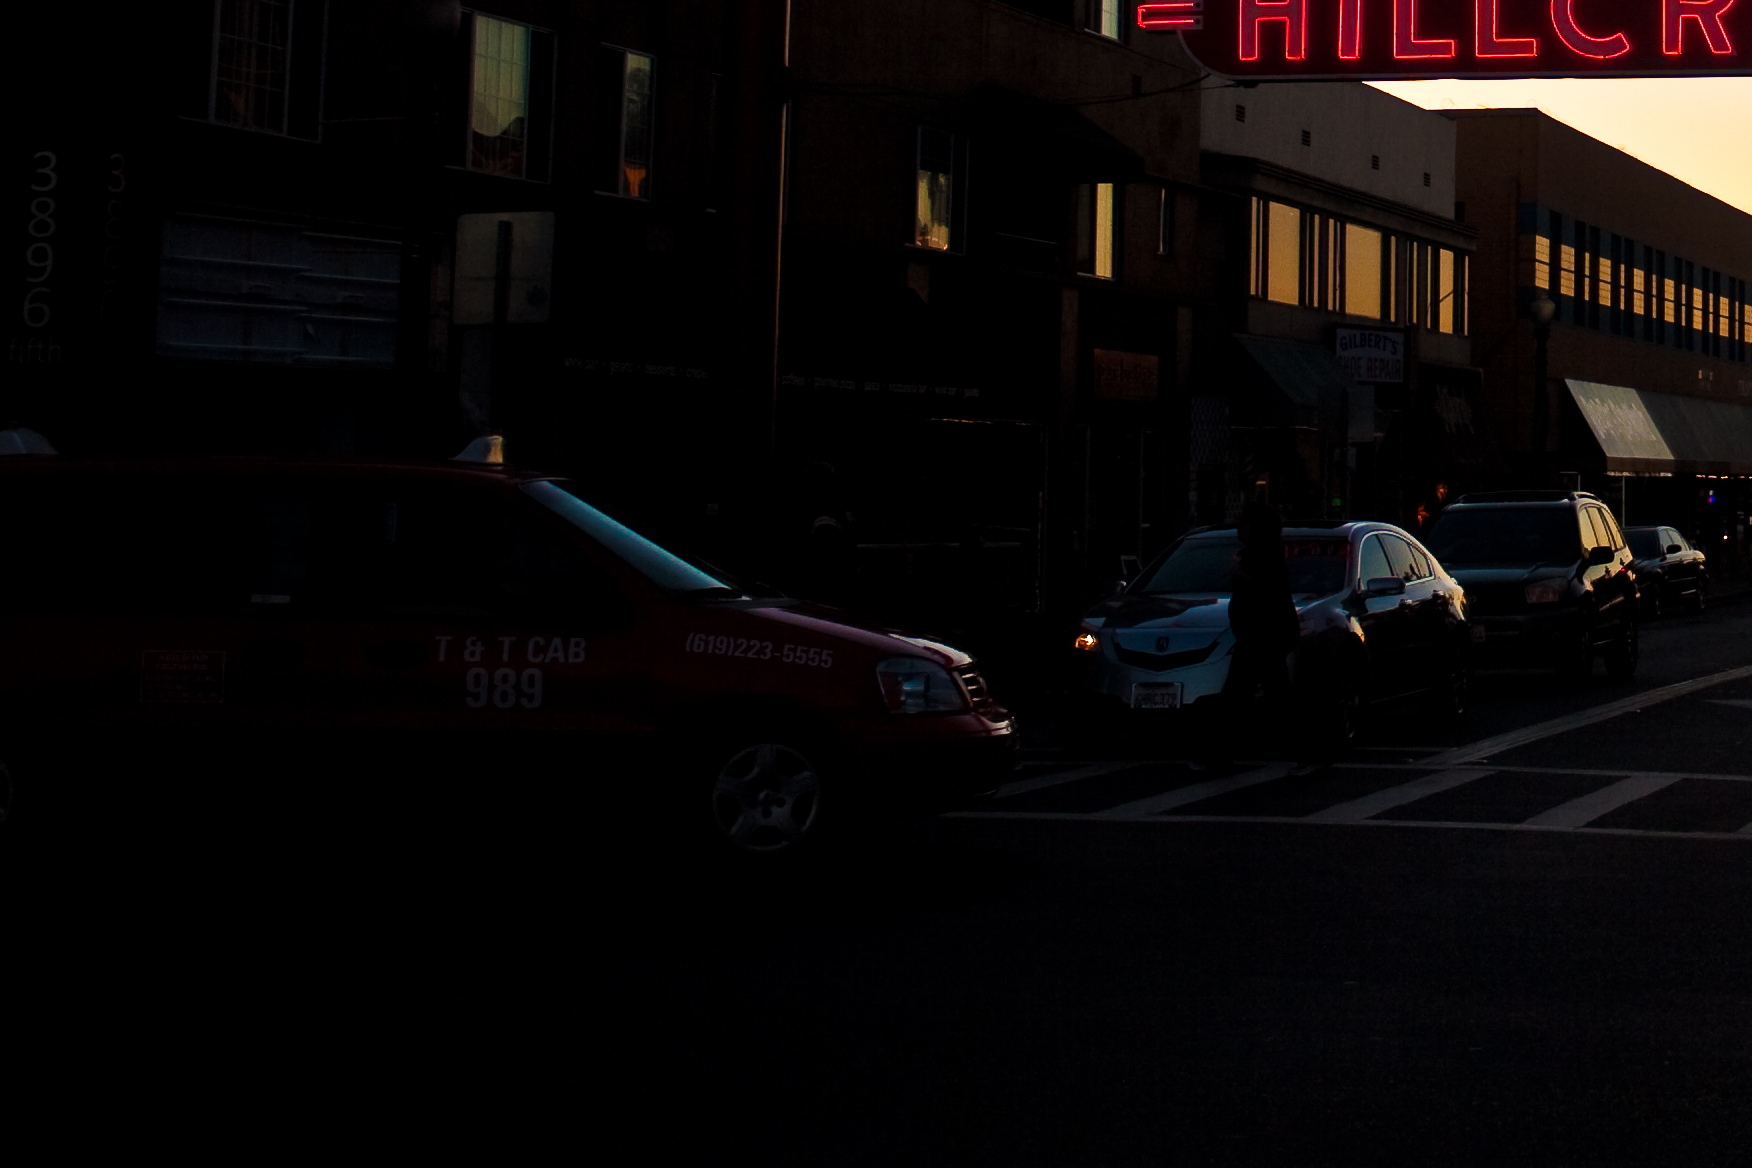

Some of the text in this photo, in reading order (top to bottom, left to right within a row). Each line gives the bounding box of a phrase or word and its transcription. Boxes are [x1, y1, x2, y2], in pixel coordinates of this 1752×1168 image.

[22, 149, 59, 330] 3896
[8, 336, 64, 363] fifth
[1339, 332, 1399, 356] GILBERT'S
[1367, 357, 1401, 380] REPAIR
[435, 635, 588, 665] T & T CAB
[684, 632, 835, 670] (619)223-5555
[465, 666, 545, 710] 989
